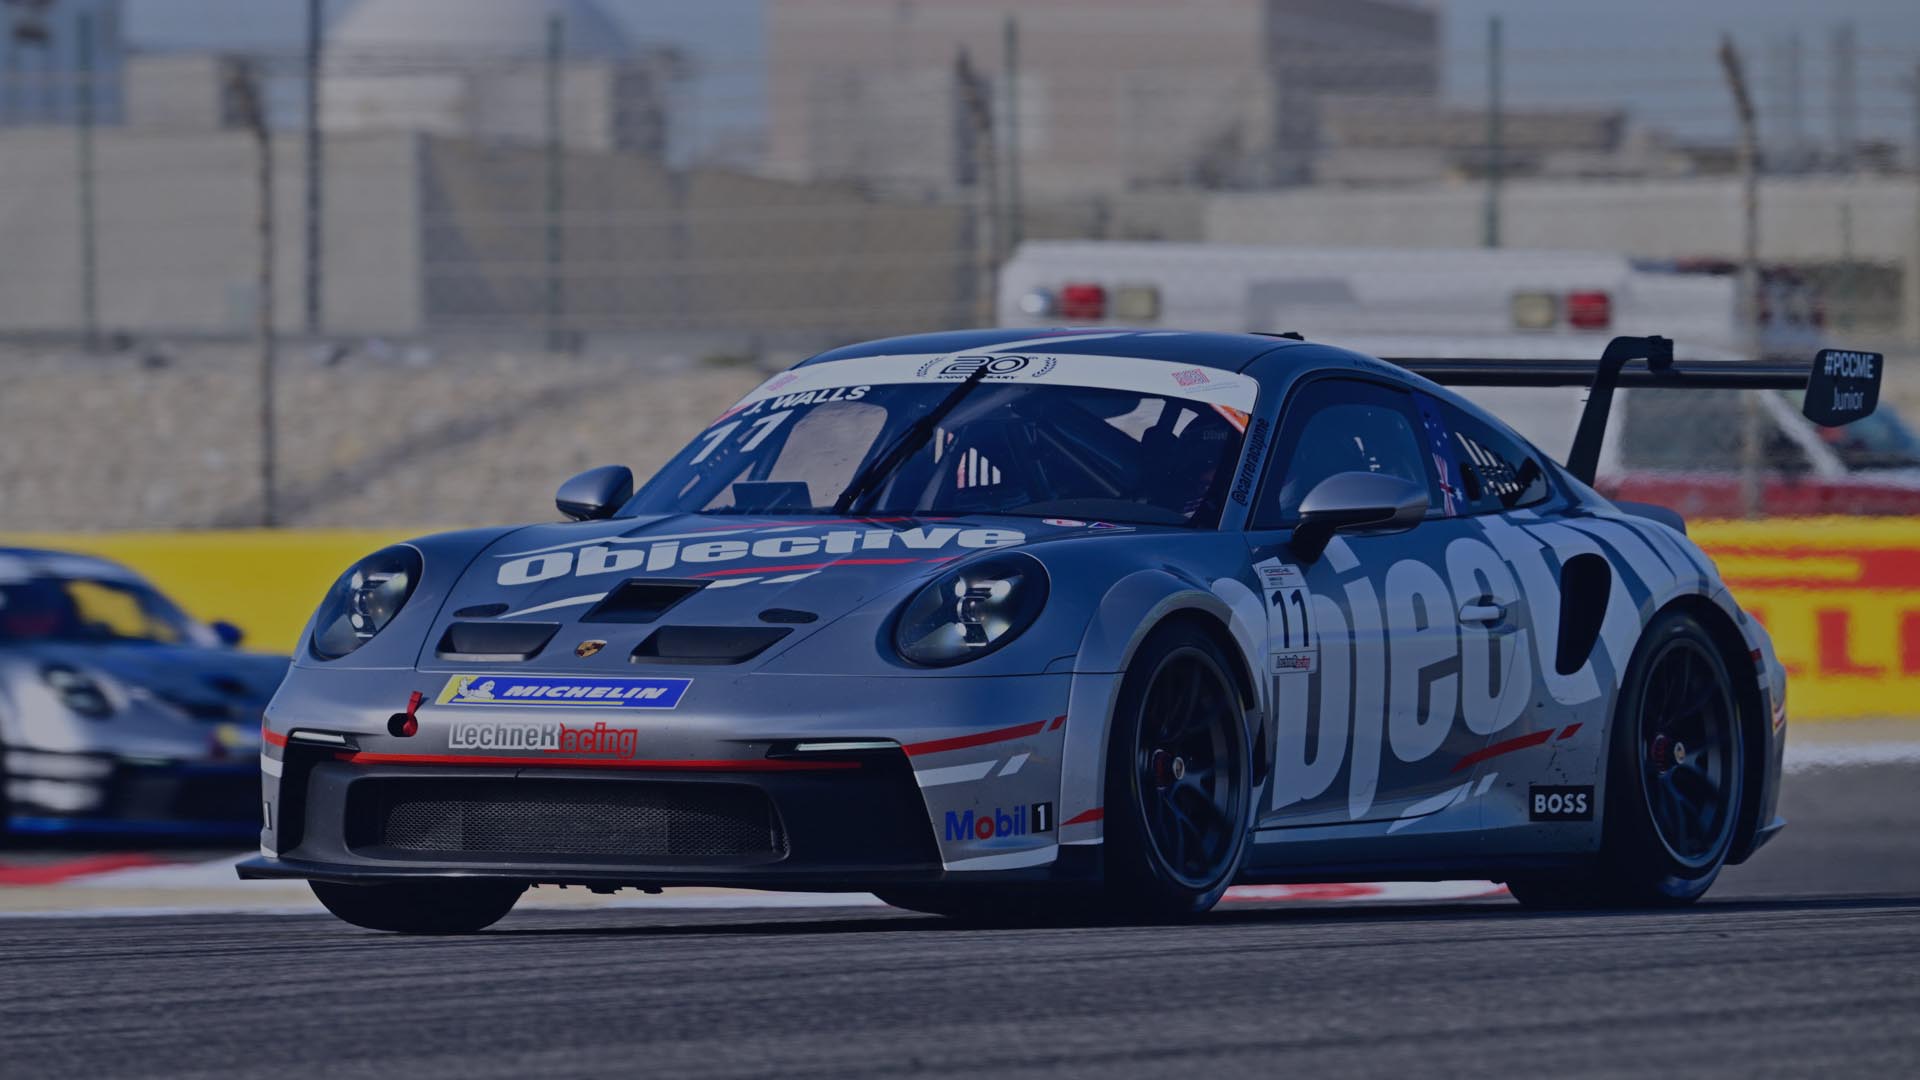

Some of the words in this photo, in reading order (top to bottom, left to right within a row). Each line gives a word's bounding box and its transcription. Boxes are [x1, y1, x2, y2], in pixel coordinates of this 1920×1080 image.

[940, 355, 1030, 375] 20
[1823, 351, 1874, 378] #PCCME
[770, 385, 871, 411] WALLS
[1831, 386, 1865, 411] Junior
[689, 410, 795, 466] 11
[1271, 589, 1309, 649] 11
[503, 685, 668, 700] MICHELIN
[1534, 793, 1587, 814] BOSS
[944, 805, 1026, 841] Mobil
